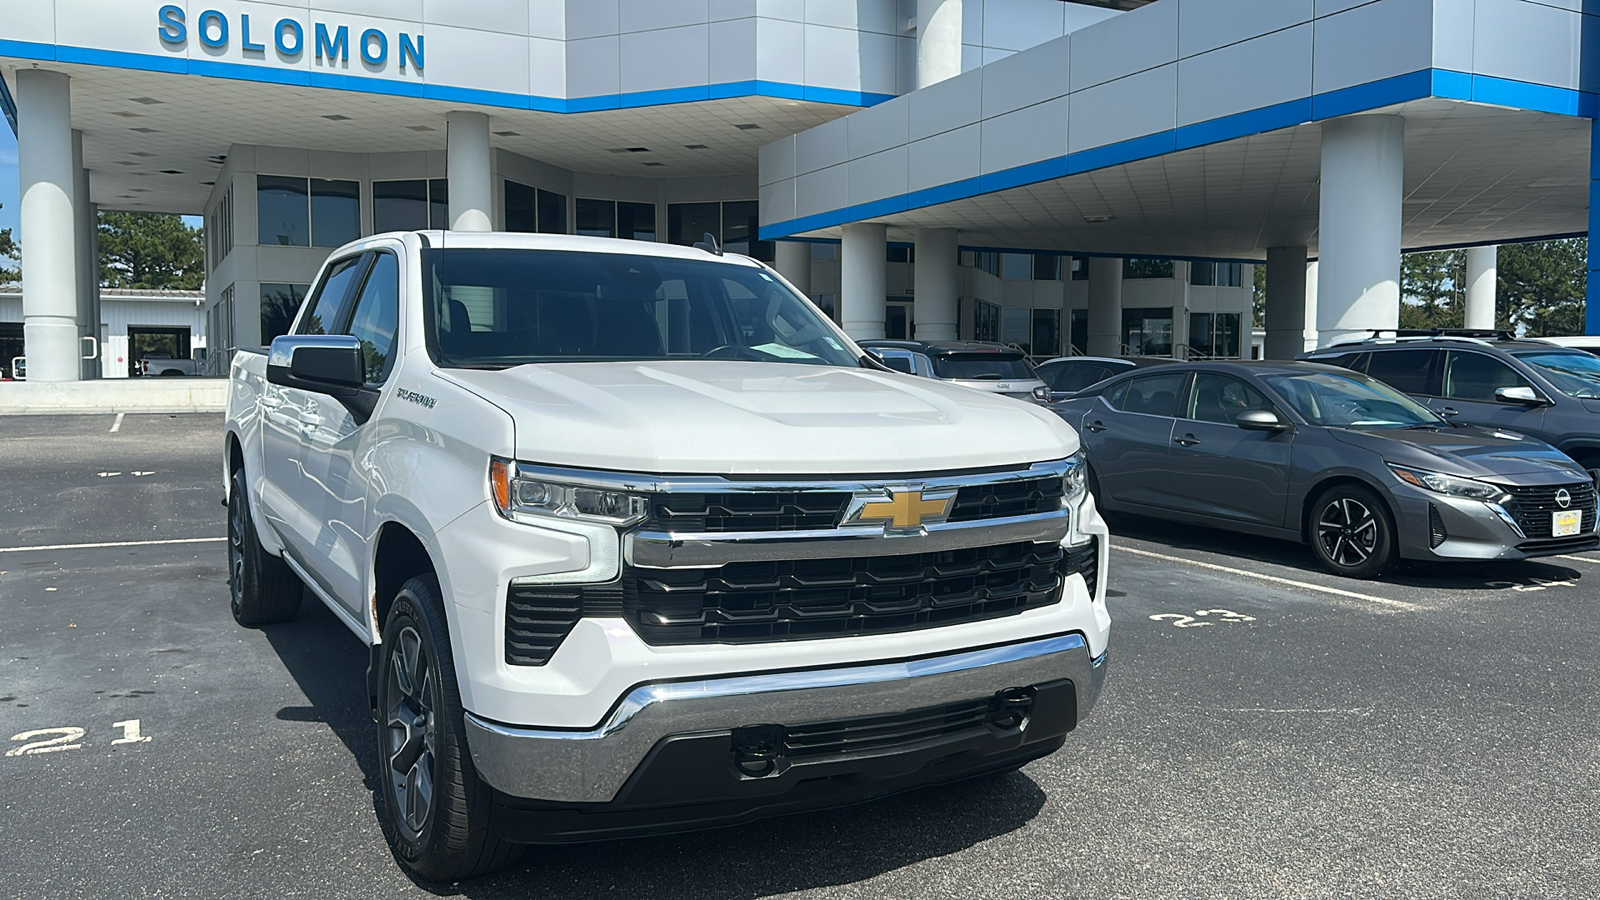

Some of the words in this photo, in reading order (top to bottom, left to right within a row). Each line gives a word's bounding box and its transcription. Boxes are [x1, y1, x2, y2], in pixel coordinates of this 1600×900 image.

[158, 4, 425, 69] SOLOMON
[1148, 608, 1257, 628] 23
[5, 718, 152, 757] 21
